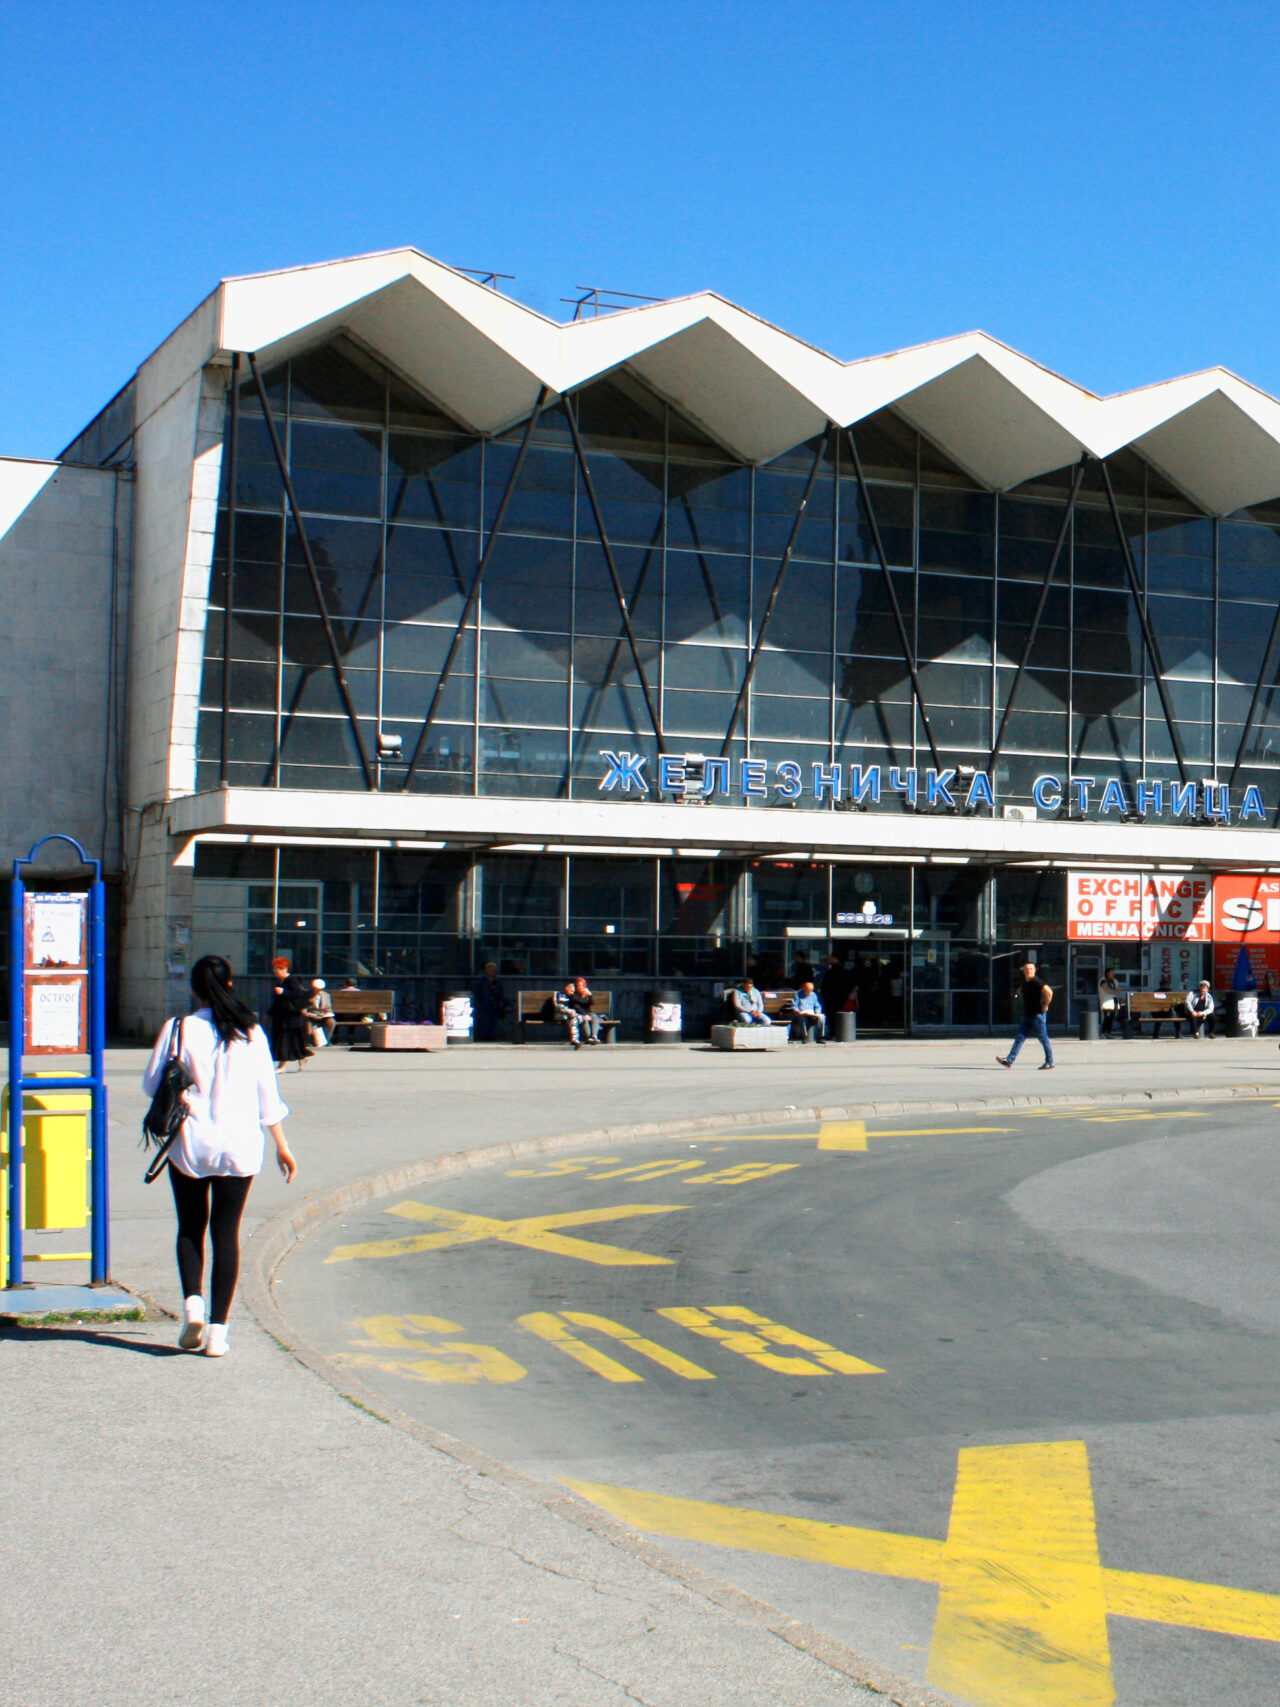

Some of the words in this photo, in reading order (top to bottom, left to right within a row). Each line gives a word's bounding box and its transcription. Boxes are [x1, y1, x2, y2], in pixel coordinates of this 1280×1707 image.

[597, 750, 997, 809] ЖЕЛЕЗНИЧКА
[1032, 774, 1267, 823] СТАНИЦА
[1077, 877, 1206, 898] EXCHANGE
[1257, 882, 1280, 893] AS
[1077, 898, 1206, 919] OFFICE
[1076, 920, 1199, 938] MENJAČNICA
[332, 1304, 887, 1385] BUS
